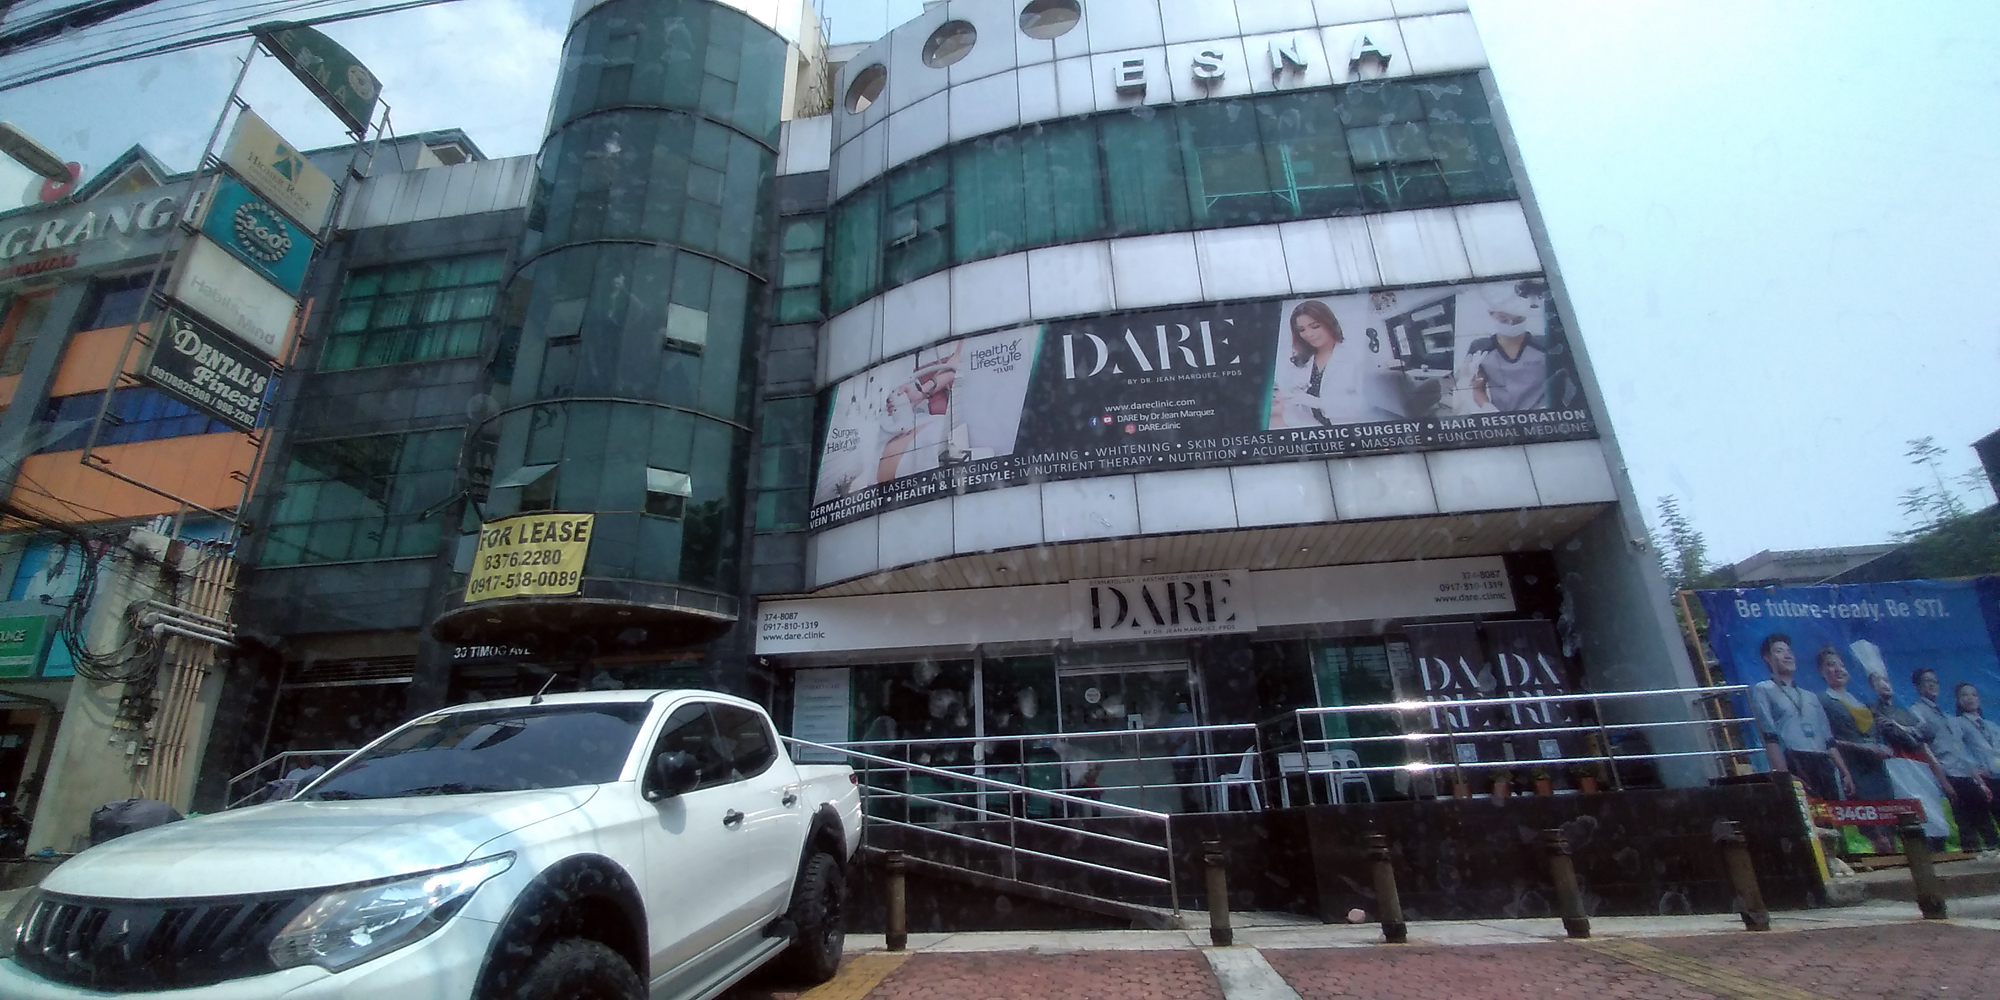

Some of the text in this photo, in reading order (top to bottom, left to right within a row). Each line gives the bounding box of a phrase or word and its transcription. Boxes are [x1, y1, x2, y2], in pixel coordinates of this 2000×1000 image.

[1114, 34, 1392, 93] ESNA
[970, 343, 1009, 360] Health
[1062, 318, 1240, 379] DARE
[970, 352, 1022, 371] Lifestyle
[1155, 375, 1176, 383] JEAN
[1222, 369, 1243, 377] FPDS
[192, 366, 260, 412] Finest
[1105, 398, 1196, 413] www.dareclinic.com
[1117, 413, 1138, 423] DARE
[1139, 413, 1150, 422] by
[1160, 411, 1179, 420] Jean
[1180, 408, 1215, 419] Marquez
[1138, 421, 1181, 432] DARE.clinic
[810, 409, 1586, 519] DERMATOLOGY: LASERS ANTI-AGING SLIMMING WHITENING SKIN DISEASE PLASTIC SURGERY HAIR RESTORATION
[810, 421, 1589, 529] VEIN TREATMENT HEALTH & LIFESTYLE: IV NUTRIENT THERAPY NUTRITION ACUPUNCTURE MASSAGE FUNCTIONAL MEDICINE
[479, 520, 590, 551] FOR LEASE
[484, 549, 562, 571] 8376.2280
[1090, 579, 1236, 629] DARE
[1736, 599, 1762, 618] Be
[1766, 599, 1884, 622] future-ready.
[1888, 599, 1911, 617] Be
[763, 621, 819, 631] 0917-810-1319
[764, 612, 799, 621] 374-8087
[762, 631, 826, 641] www.dare.clinic
[470, 644, 507, 658] TIMOG
[1419, 655, 1481, 691] DA
[1498, 652, 1561, 687] DA
[1835, 805, 1878, 821] 34GB
